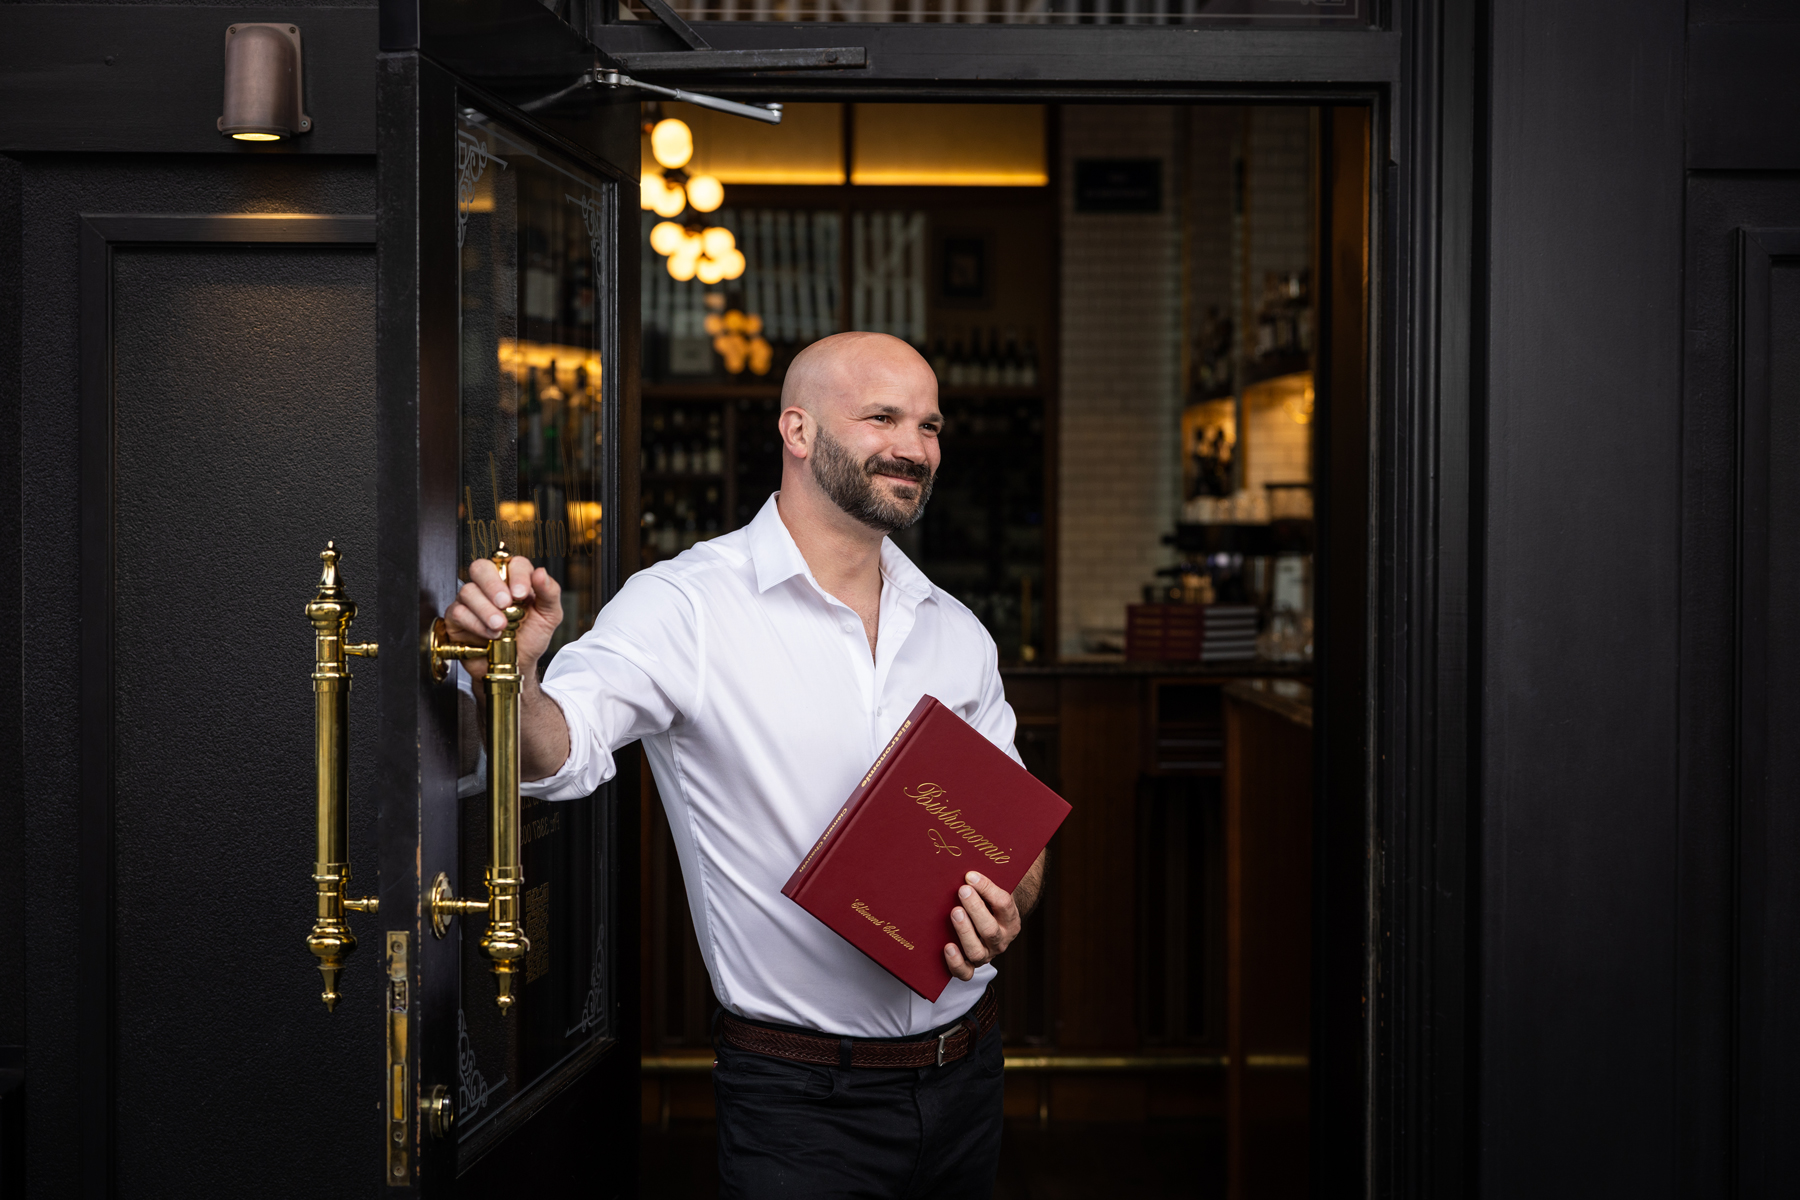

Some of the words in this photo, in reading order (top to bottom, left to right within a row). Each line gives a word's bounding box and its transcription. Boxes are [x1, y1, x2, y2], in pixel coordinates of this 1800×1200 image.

[861, 720, 911, 787] Bistronomie
[903, 782, 1012, 864] Bistronomie
[799, 841, 823, 873] Chauvin
[883, 922, 914, 950] Chauvin
